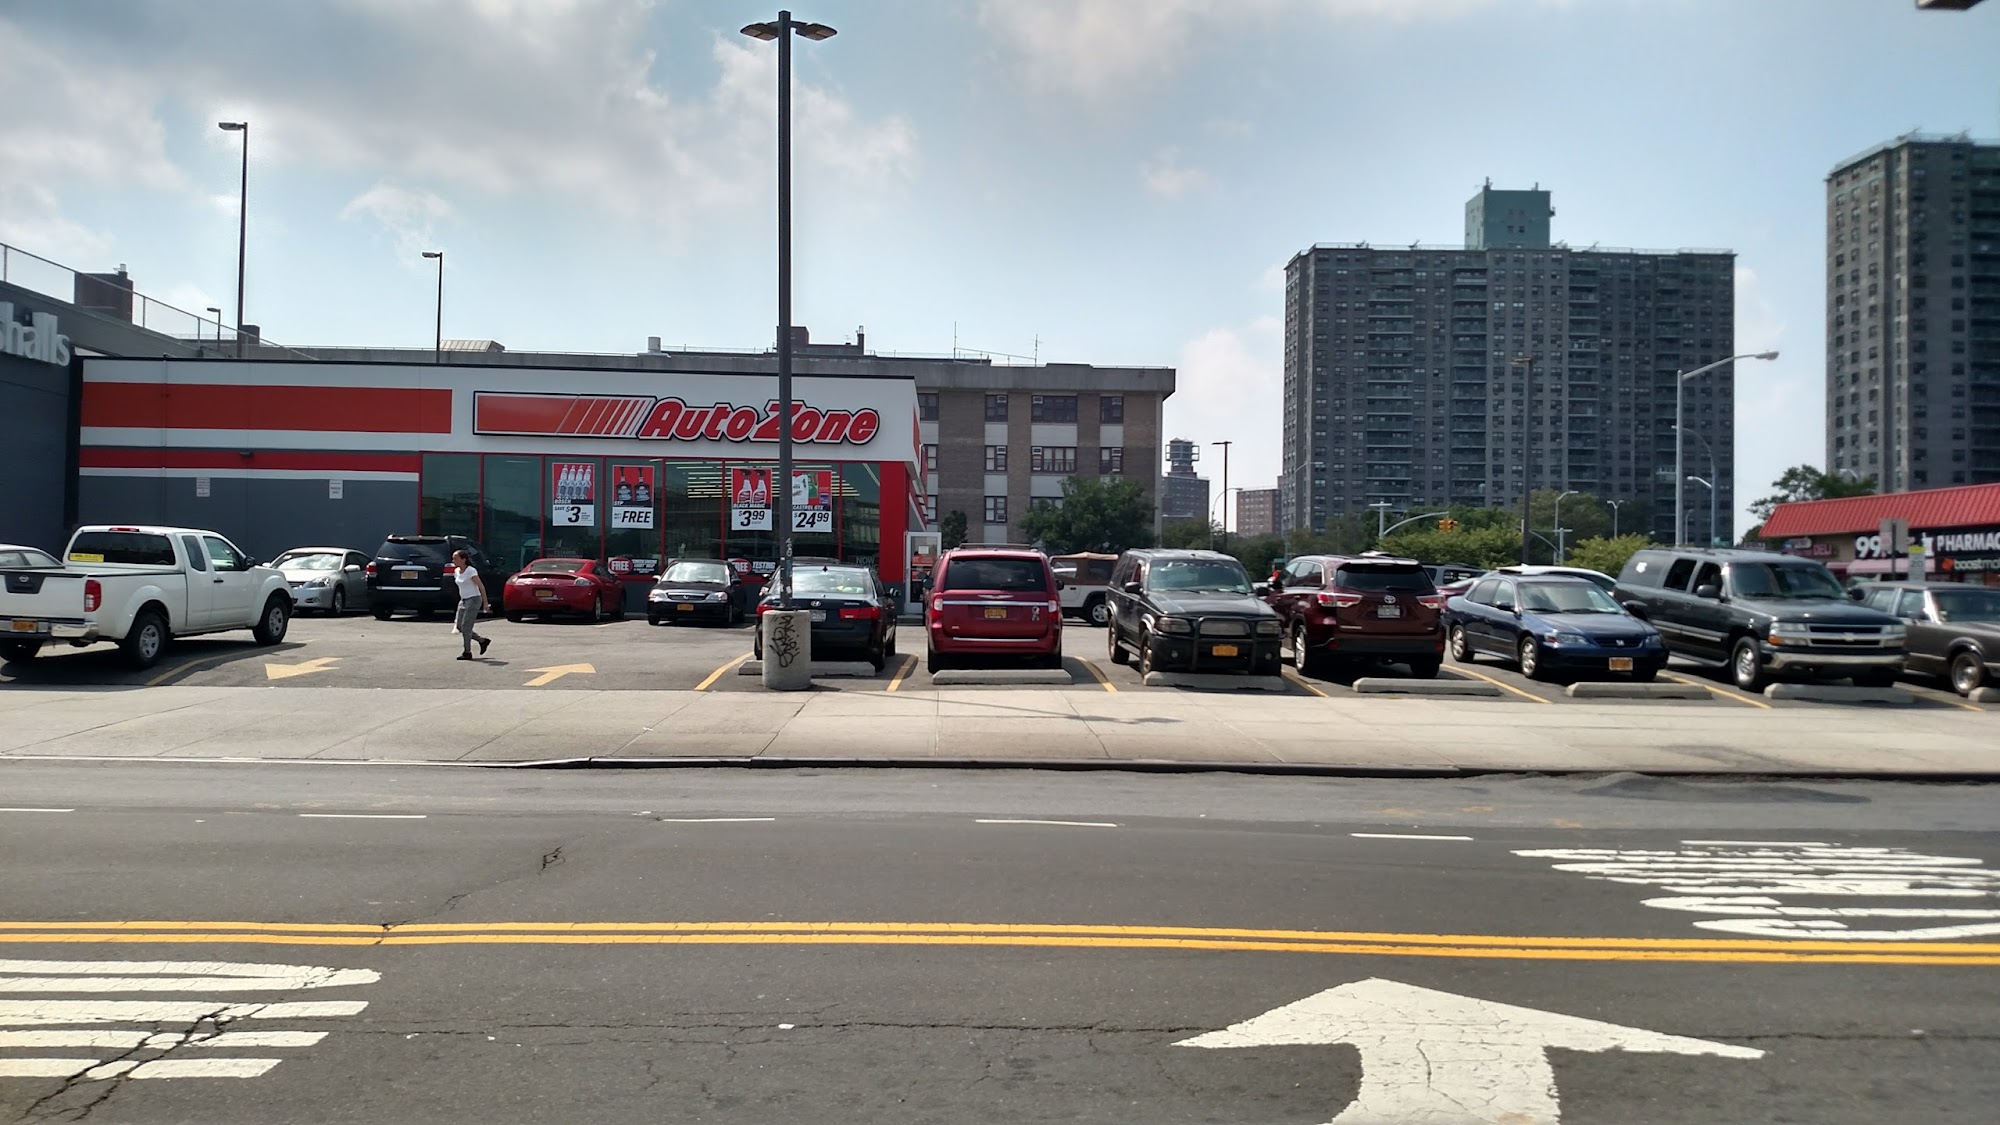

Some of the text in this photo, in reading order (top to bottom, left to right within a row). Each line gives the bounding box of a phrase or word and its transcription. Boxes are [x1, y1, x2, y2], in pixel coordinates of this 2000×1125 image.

[637, 398, 879, 444] AutoZone
[565, 506, 581, 523] $3
[621, 510, 652, 523] FREE
[611, 561, 629, 571] FREE
